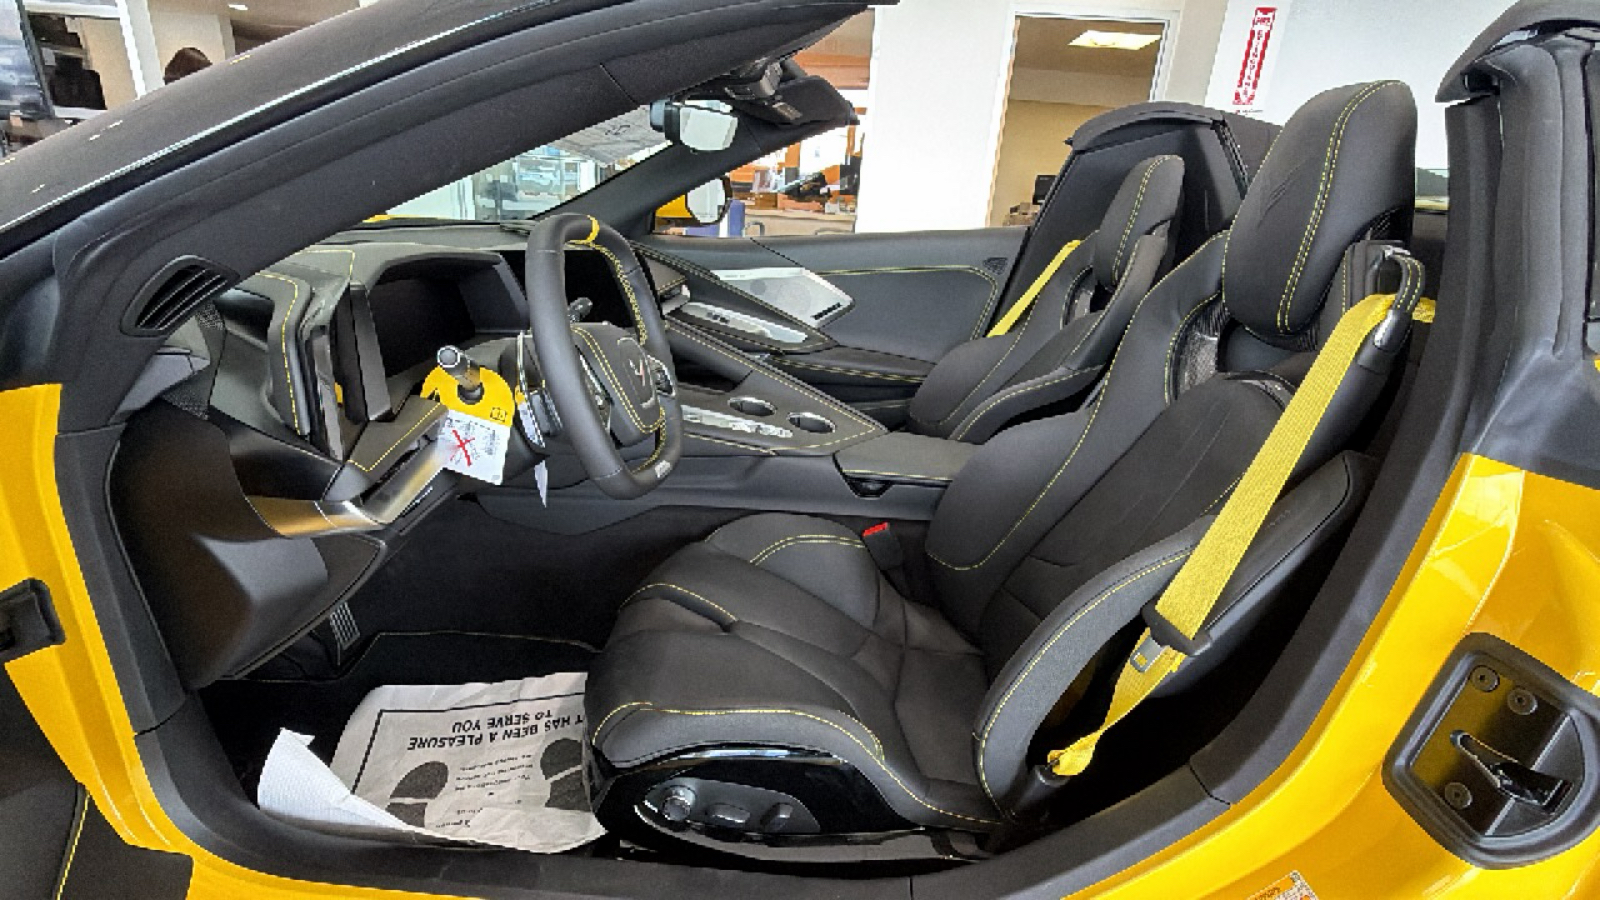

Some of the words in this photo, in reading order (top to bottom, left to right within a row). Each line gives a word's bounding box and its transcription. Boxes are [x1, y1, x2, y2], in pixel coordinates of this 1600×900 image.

[487, 712, 530, 729] SERVE
[534, 710, 552, 721] TO
[544, 715, 571, 732] HAS
[452, 719, 481, 733] YOU
[502, 724, 538, 740] BEEN
[407, 733, 483, 750] PLEASURE
[489, 732, 498, 743] A
